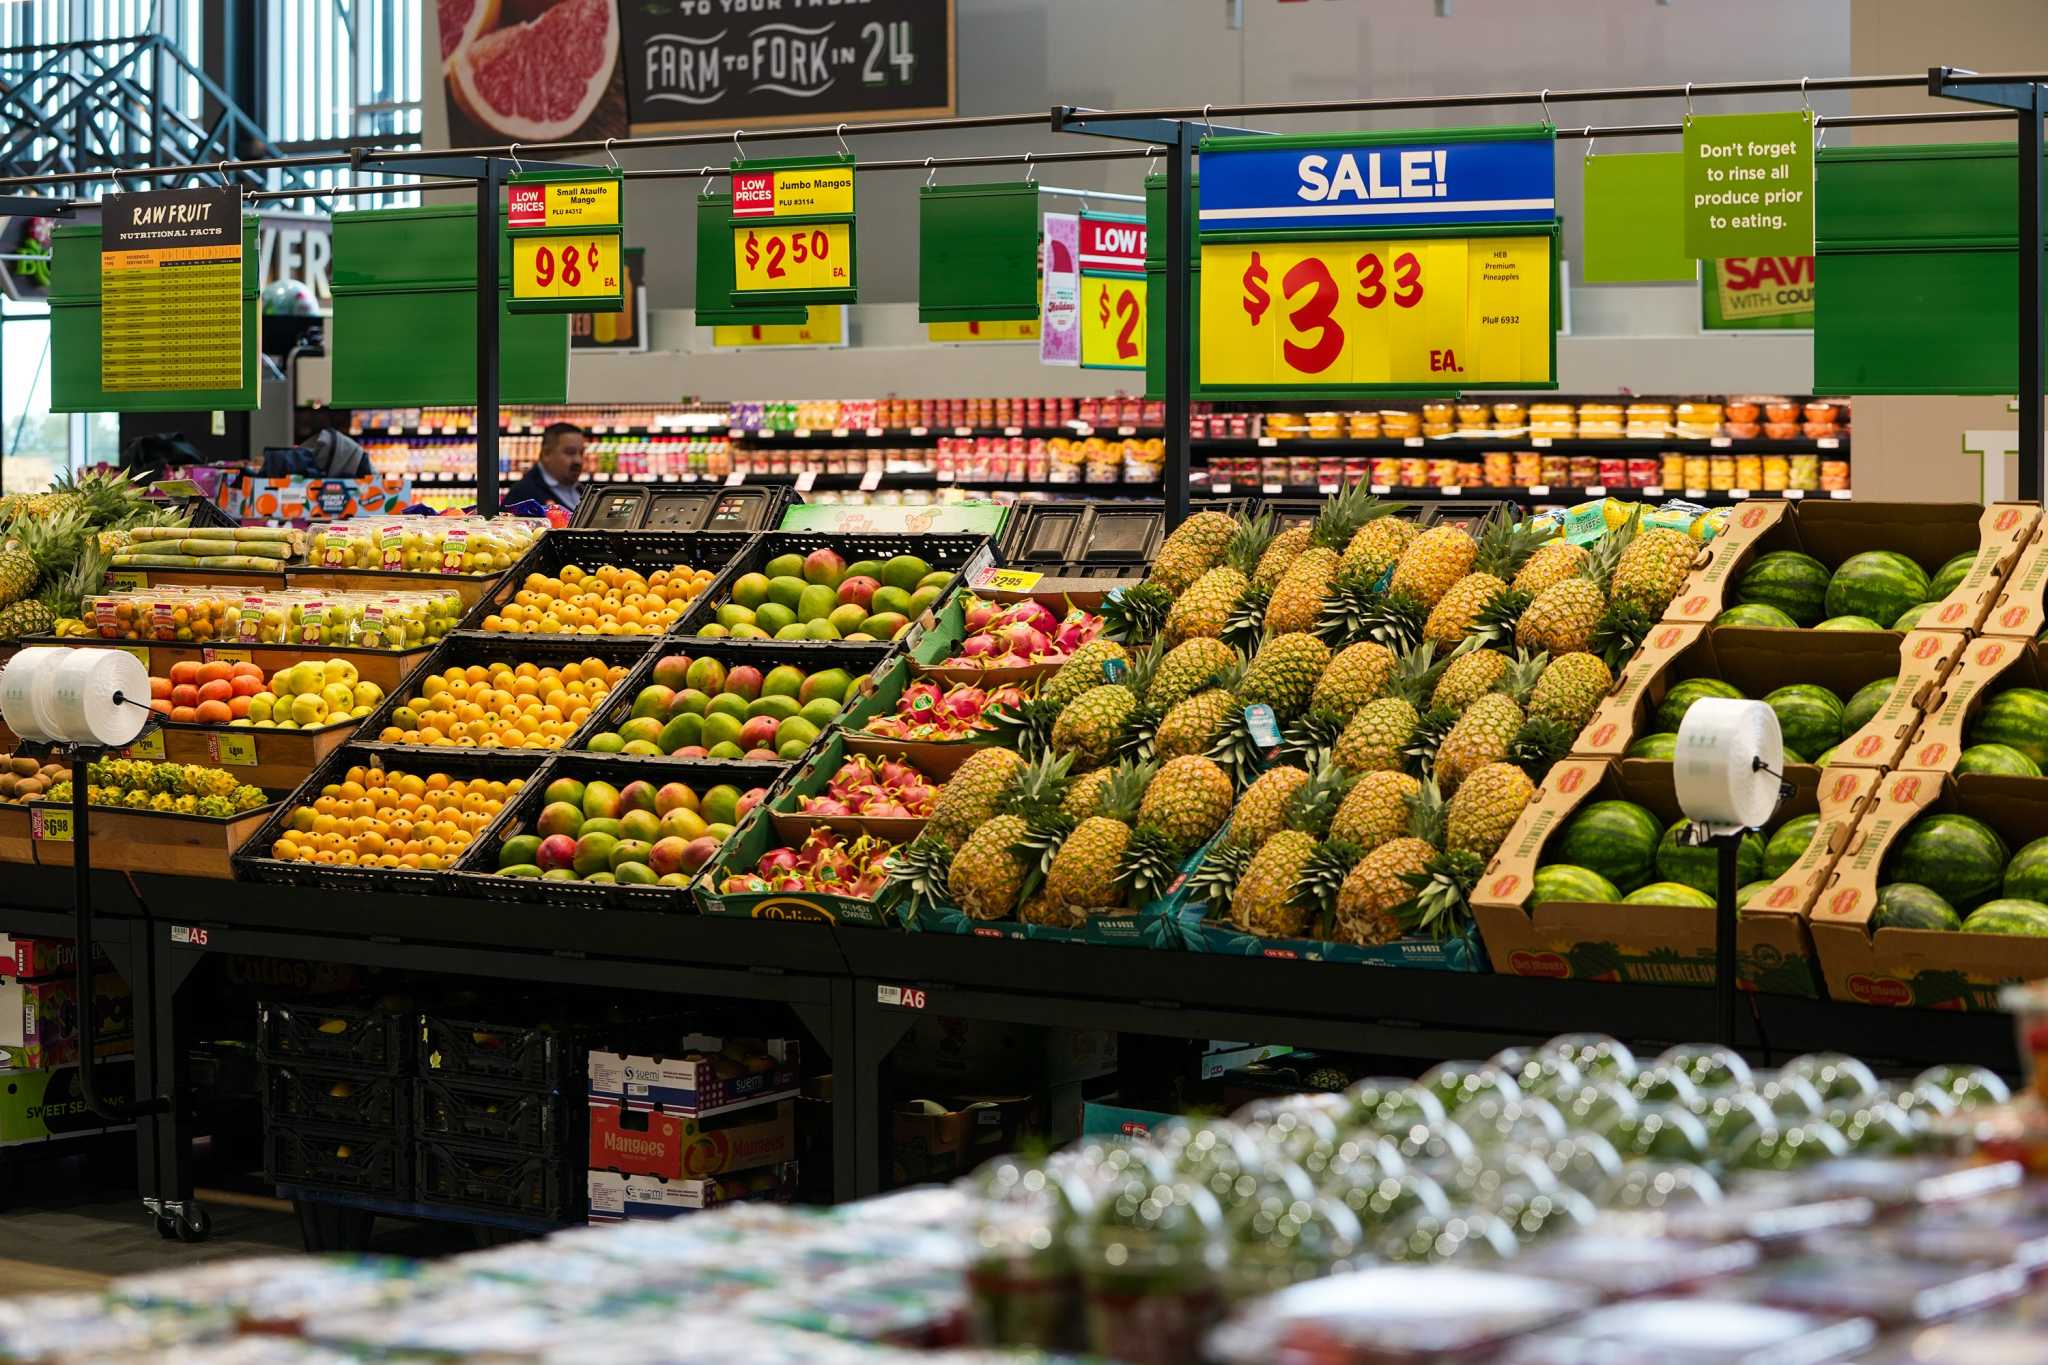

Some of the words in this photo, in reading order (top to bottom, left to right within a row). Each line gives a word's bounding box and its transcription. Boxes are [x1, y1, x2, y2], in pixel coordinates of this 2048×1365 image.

[680, 0, 711, 16] TO
[646, 44, 720, 93] FARM
[723, 55, 749, 71] TO
[752, 36, 830, 85] FORK
[832, 48, 855, 64] IN
[861, 21, 914, 82] 24
[1700, 143, 1743, 158] Don't
[1747, 141, 1796, 158] forget
[1297, 150, 1447, 202] SALE!
[1707, 168, 1724, 181] to
[1728, 166, 1766, 181] rinse
[1771, 164, 1789, 180] all
[557, 188, 578, 196] Small
[579, 187, 607, 195] Ataulfo
[741, 180, 765, 190] LOW
[780, 181, 811, 190] Jumbo
[814, 178, 851, 190] Mangos
[516, 191, 539, 202] LOW
[570, 196, 596, 205] Mango
[735, 190, 772, 201] PRICES
[1694, 191, 1760, 208] produce
[1764, 188, 1803, 206] prior
[133, 206, 167, 226] RAW
[168, 203, 212, 223] FRUIT
[511, 202, 545, 212] PRICES
[1710, 215, 1727, 229] to
[1731, 213, 1787, 230] eating.
[120, 230, 188, 240] NUTRITIONAL
[190, 227, 223, 236] FACTS
[1095, 228, 1136, 253] LOW
[1493, 251, 1508, 259] HEB
[535, 242, 599, 288] 98¢
[833, 267, 846, 278] EA.
[1485, 262, 1516, 271] Premium
[604, 277, 617, 287] EA.
[1483, 272, 1520, 282] Pineapples
[1724, 256, 1814, 292] SAV
[1730, 292, 1772, 310] WITH
[1481, 315, 1499, 325] Plu#
[1500, 315, 1520, 325] 6932
[1429, 349, 1464, 373] EA.
[43, 819, 69, 836] $698
[190, 928, 208, 945] A5
[902, 989, 925, 1008] A6
[26, 1102, 66, 1119] SWEET
[604, 1130, 665, 1159] Mangoes
